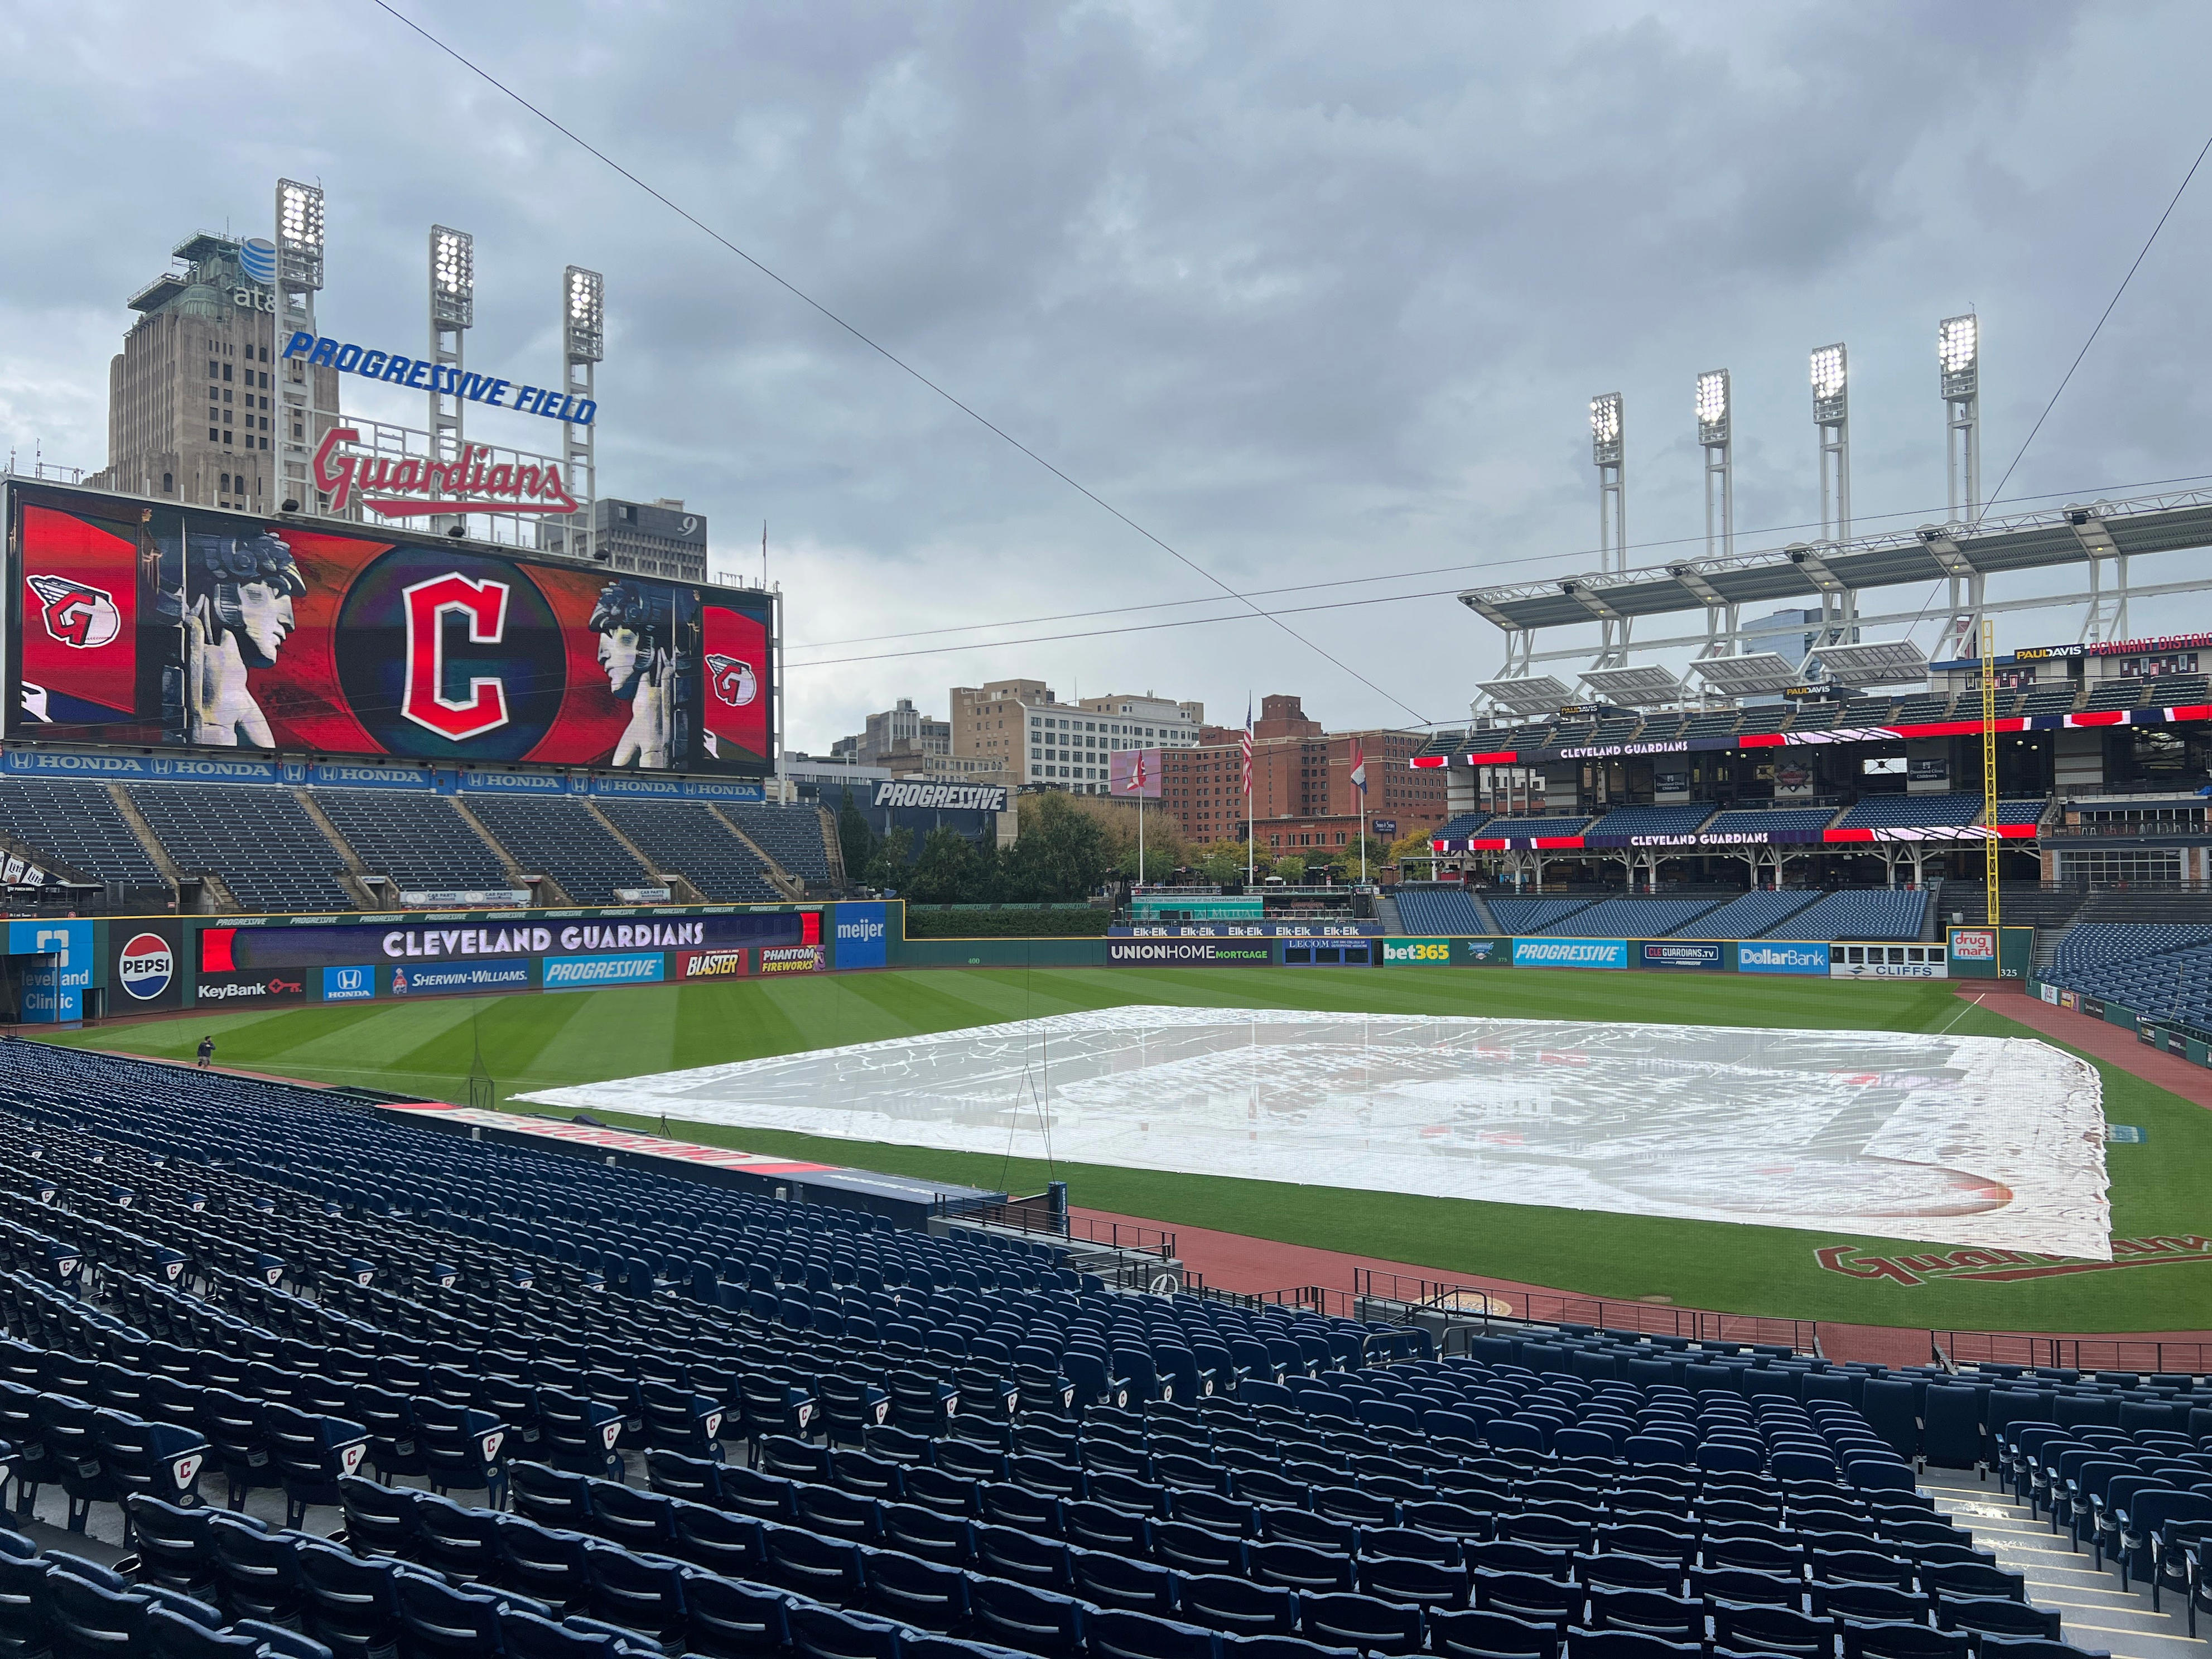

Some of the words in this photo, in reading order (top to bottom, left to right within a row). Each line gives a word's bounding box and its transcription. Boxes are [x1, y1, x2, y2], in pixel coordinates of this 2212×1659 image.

[282, 331, 511, 407] PROGRESSIVE
[513, 384, 597, 426] FIELD
[312, 426, 579, 518] Guardians
[681, 517, 698, 536] 9
[2090, 638, 2154, 656] PENNANT
[401, 571, 510, 741] C
[1560, 746, 1621, 759] CLEVELAND
[1625, 741, 1688, 755] GUARDIANS
[37, 755, 143, 771] HONDA
[176, 761, 272, 777] HONDA
[340, 768, 424, 783] HONDA
[486, 775, 560, 788] HONDA
[614, 781, 679, 793] HONDA
[698, 785, 758, 796] HONDA
[874, 782, 1006, 811] PROGRESSIVE
[1631, 834, 1696, 846] CLEVELAND
[1700, 832, 1768, 844] GUARDIANS
[8, 862, 23, 873] Lite
[28, 872, 42, 884] Lite
[215, 917, 268, 927] PROGRESSIVE
[290, 915, 339, 925] PROGRESSIVE
[359, 914, 406, 923] PROGRESSIVE
[425, 913, 469, 921] PROGRESSIVE
[837, 918, 884, 942] meijer
[382, 928, 552, 958] CLEVELAND
[560, 922, 703, 951] GUARDIANS
[1955, 932, 1987, 947] drug
[763, 948, 815, 961] PHANTOM
[1216, 950, 1268, 959] MORTGAGE
[1384, 944, 1449, 960] bet365
[1515, 944, 1619, 962] PROGRESSIVE
[1959, 947, 1994, 956] mart
[123, 958, 170, 974] PEPSI
[546, 959, 656, 982] PROGRESSIVE
[686, 954, 739, 976] BLASTER
[762, 960, 815, 972] FIREWORKS
[1876, 966, 1933, 976] CLIFFS
[2000, 968, 2018, 977] 325
[198, 983, 266, 999] KeyBank
[328, 990, 370, 999] HONDA
[63, 1262, 70, 1271] C
[170, 1266, 177, 1275] C
[271, 1271, 277, 1280] C
[362, 1275, 368, 1283] C
[802, 1409, 807, 1420] C
[879, 1406, 884, 1417] C
[710, 1417, 716, 1430] C
[607, 1427, 614, 1441] C
[487, 1438, 496, 1453] C
[348, 1450, 356, 1466] C
[180, 1461, 191, 1479] C
